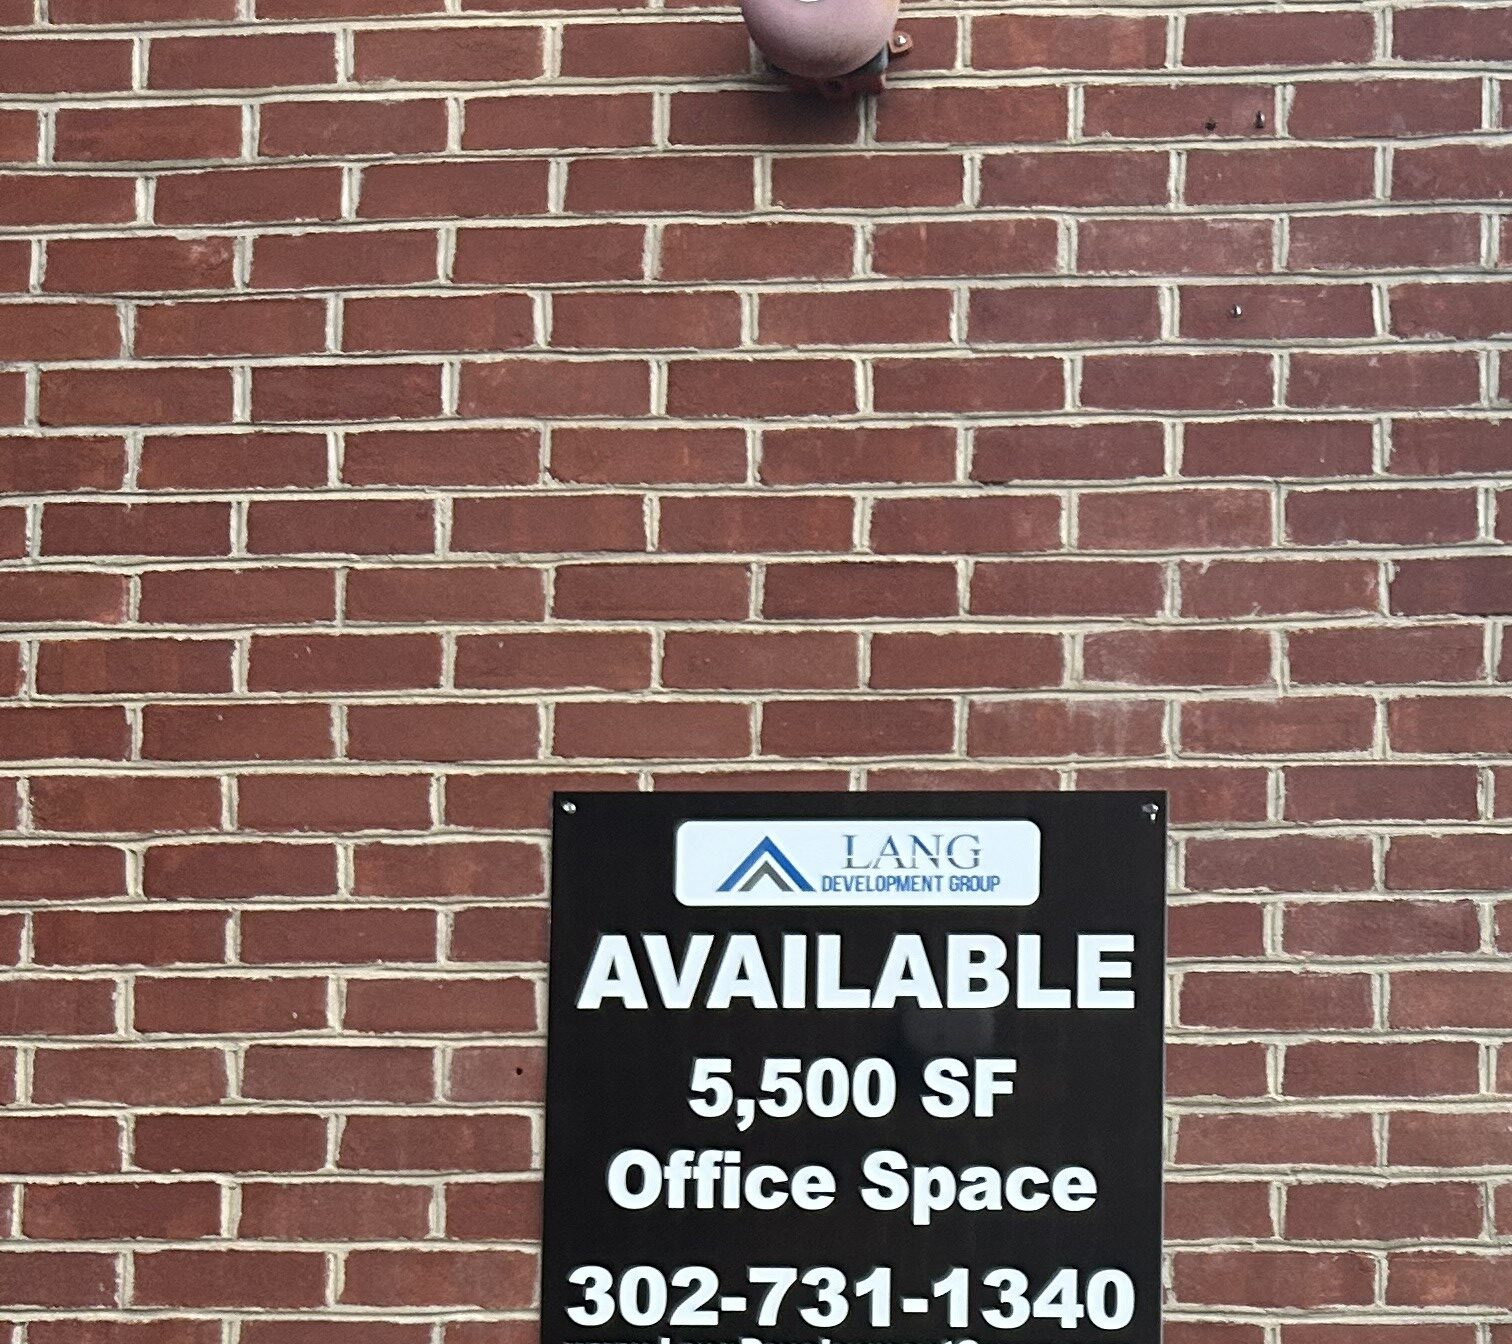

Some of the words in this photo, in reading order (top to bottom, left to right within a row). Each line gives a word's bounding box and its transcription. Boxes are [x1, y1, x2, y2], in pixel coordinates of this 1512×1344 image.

[821, 874, 944, 893] DEVELOPMENT
[948, 874, 1001, 893] GROUP
[844, 834, 982, 870] LANG
[576, 934, 1135, 1010] AVAILABLE
[688, 1057, 897, 1132] 5,500
[921, 1057, 1017, 1118] SF
[607, 1149, 836, 1211] Office
[860, 1150, 1098, 1226] Space
[567, 1265, 1135, 1330] 302-731-1340
